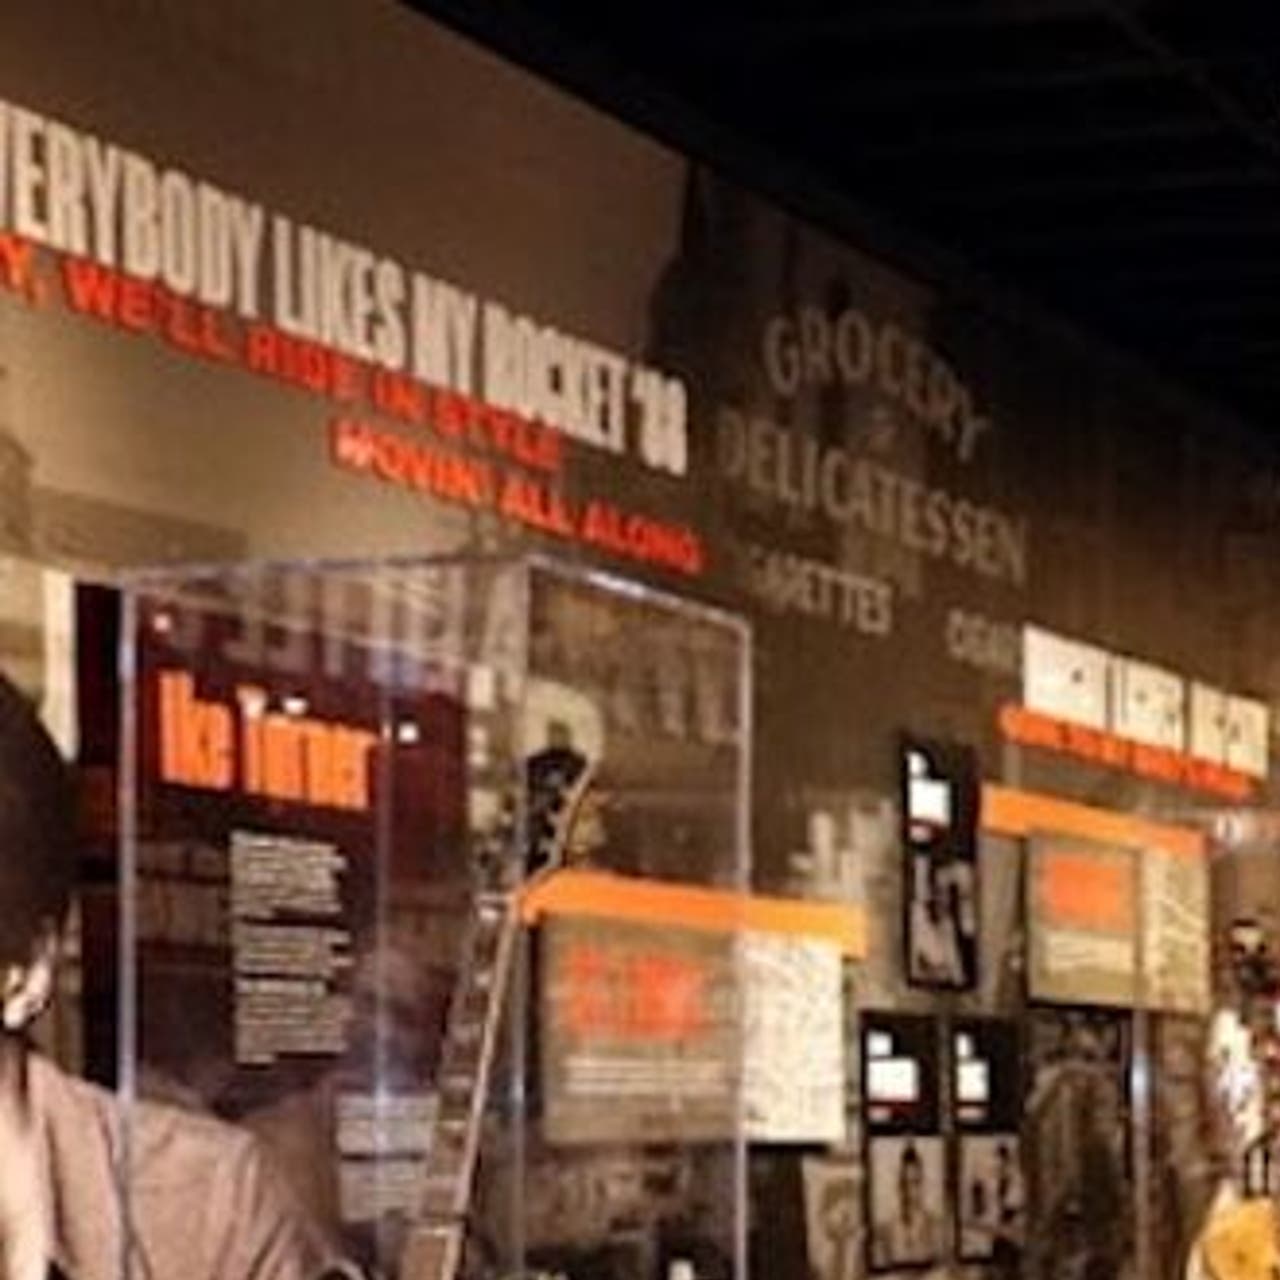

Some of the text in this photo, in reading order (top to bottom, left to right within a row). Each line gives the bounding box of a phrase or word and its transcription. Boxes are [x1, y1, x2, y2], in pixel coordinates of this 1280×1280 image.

[272, 212, 406, 371] LIKES
[411, 270, 480, 399] MY
[483, 300, 627, 455] ROCKET
[762, 306, 991, 463] GROCERY
[716, 407, 1029, 586] DELICATESSEN
